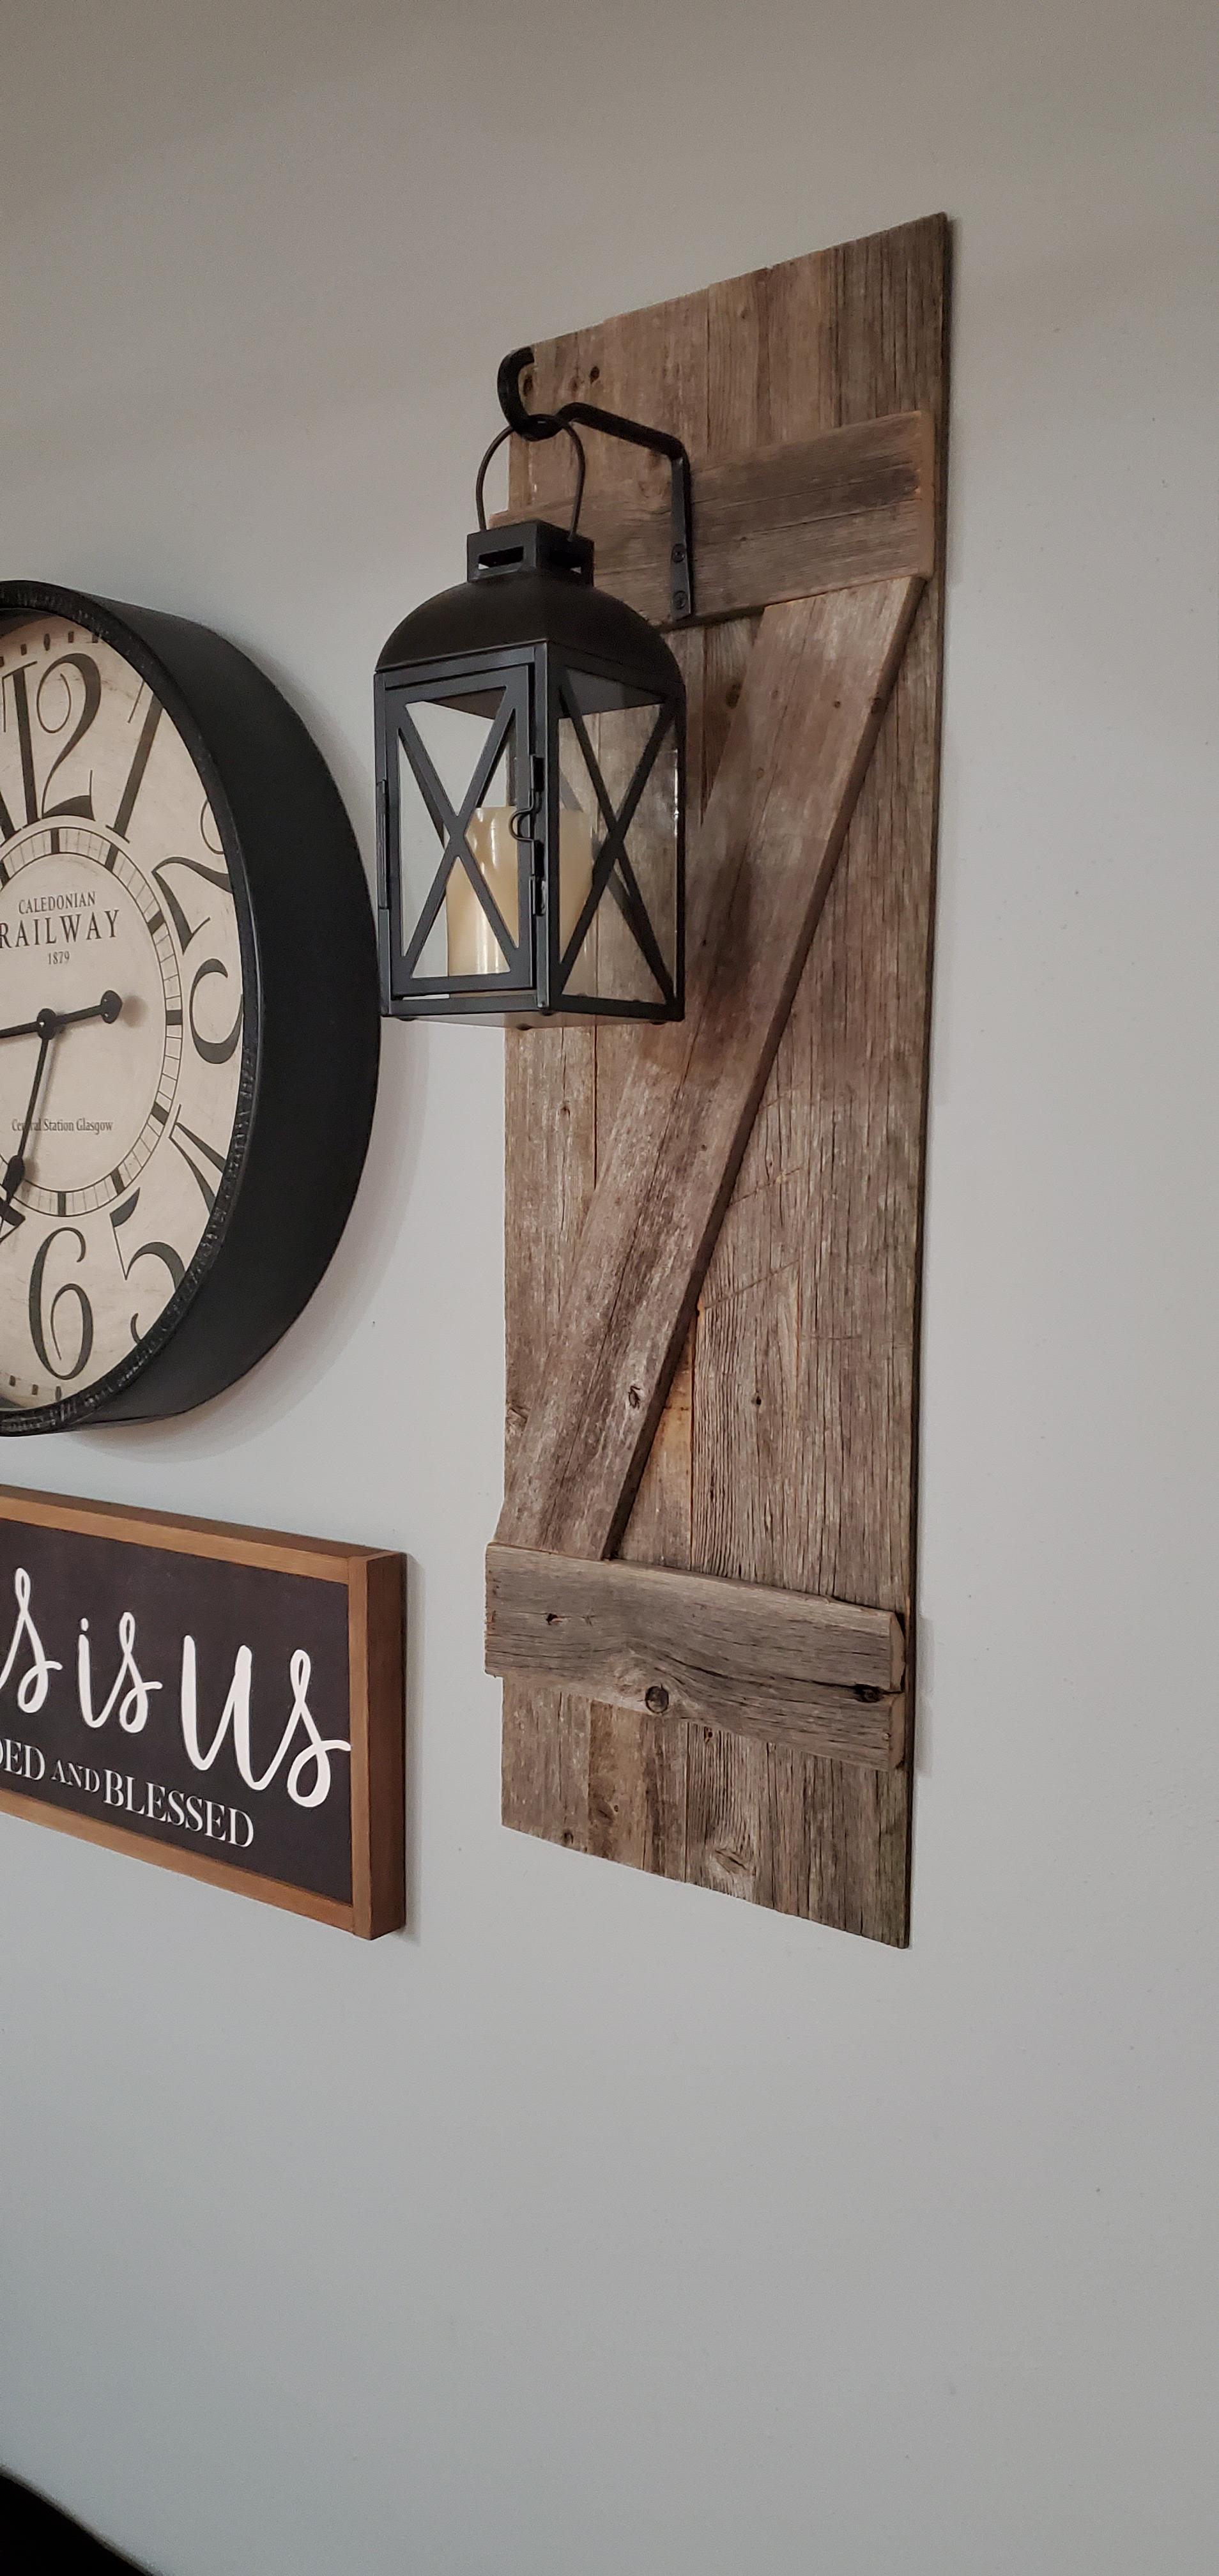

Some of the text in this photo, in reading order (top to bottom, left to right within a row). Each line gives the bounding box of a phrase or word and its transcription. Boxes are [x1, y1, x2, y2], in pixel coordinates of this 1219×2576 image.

[2, 653, 102, 825] 12
[0, 909, 119, 949] RAILWAY
[19, 891, 96, 915] CALEDONIAN
[48, 951, 70, 965] 1879
[44, 1119, 73, 1131] Station
[76, 1117, 113, 1135] Glasgow
[29, 1227, 94, 1380] 6
[78, 1612, 163, 1733] is
[50, 1759, 100, 1793] AND
[103, 1768, 254, 1848] BLESSED
